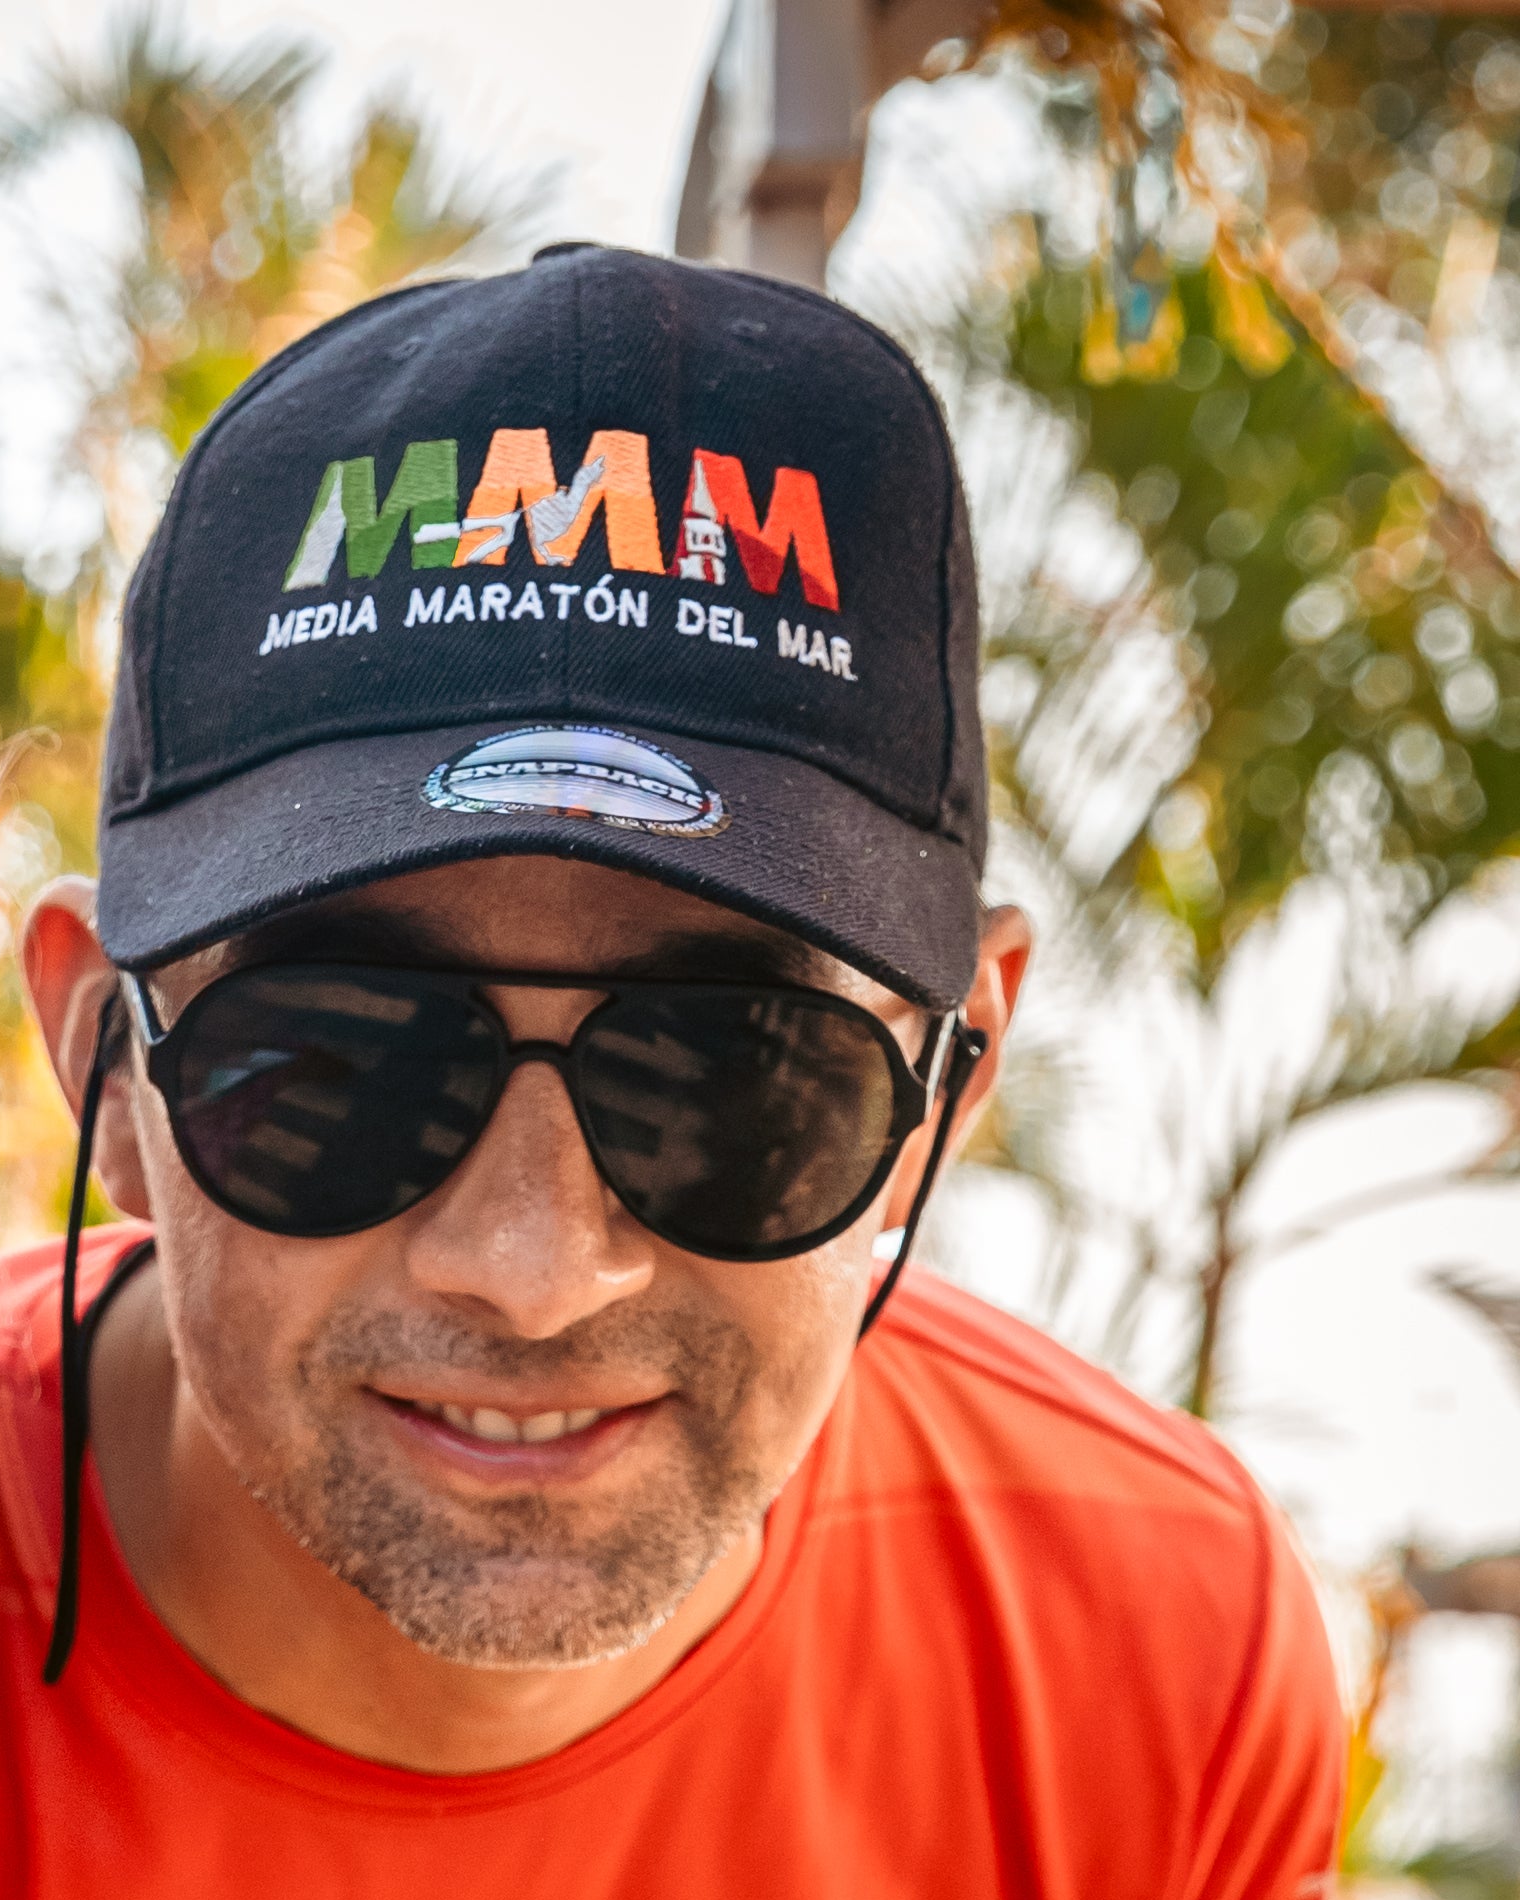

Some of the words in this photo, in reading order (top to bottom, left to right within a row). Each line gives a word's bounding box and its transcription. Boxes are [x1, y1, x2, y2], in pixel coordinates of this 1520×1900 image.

[283, 427, 841, 613] MMM
[259, 595, 378, 655] MEDIA
[403, 574, 648, 628] MARATÓN
[676, 605, 757, 648] DEL
[777, 618, 858, 681] MAR
[446, 760, 706, 808] SNAPBACK
